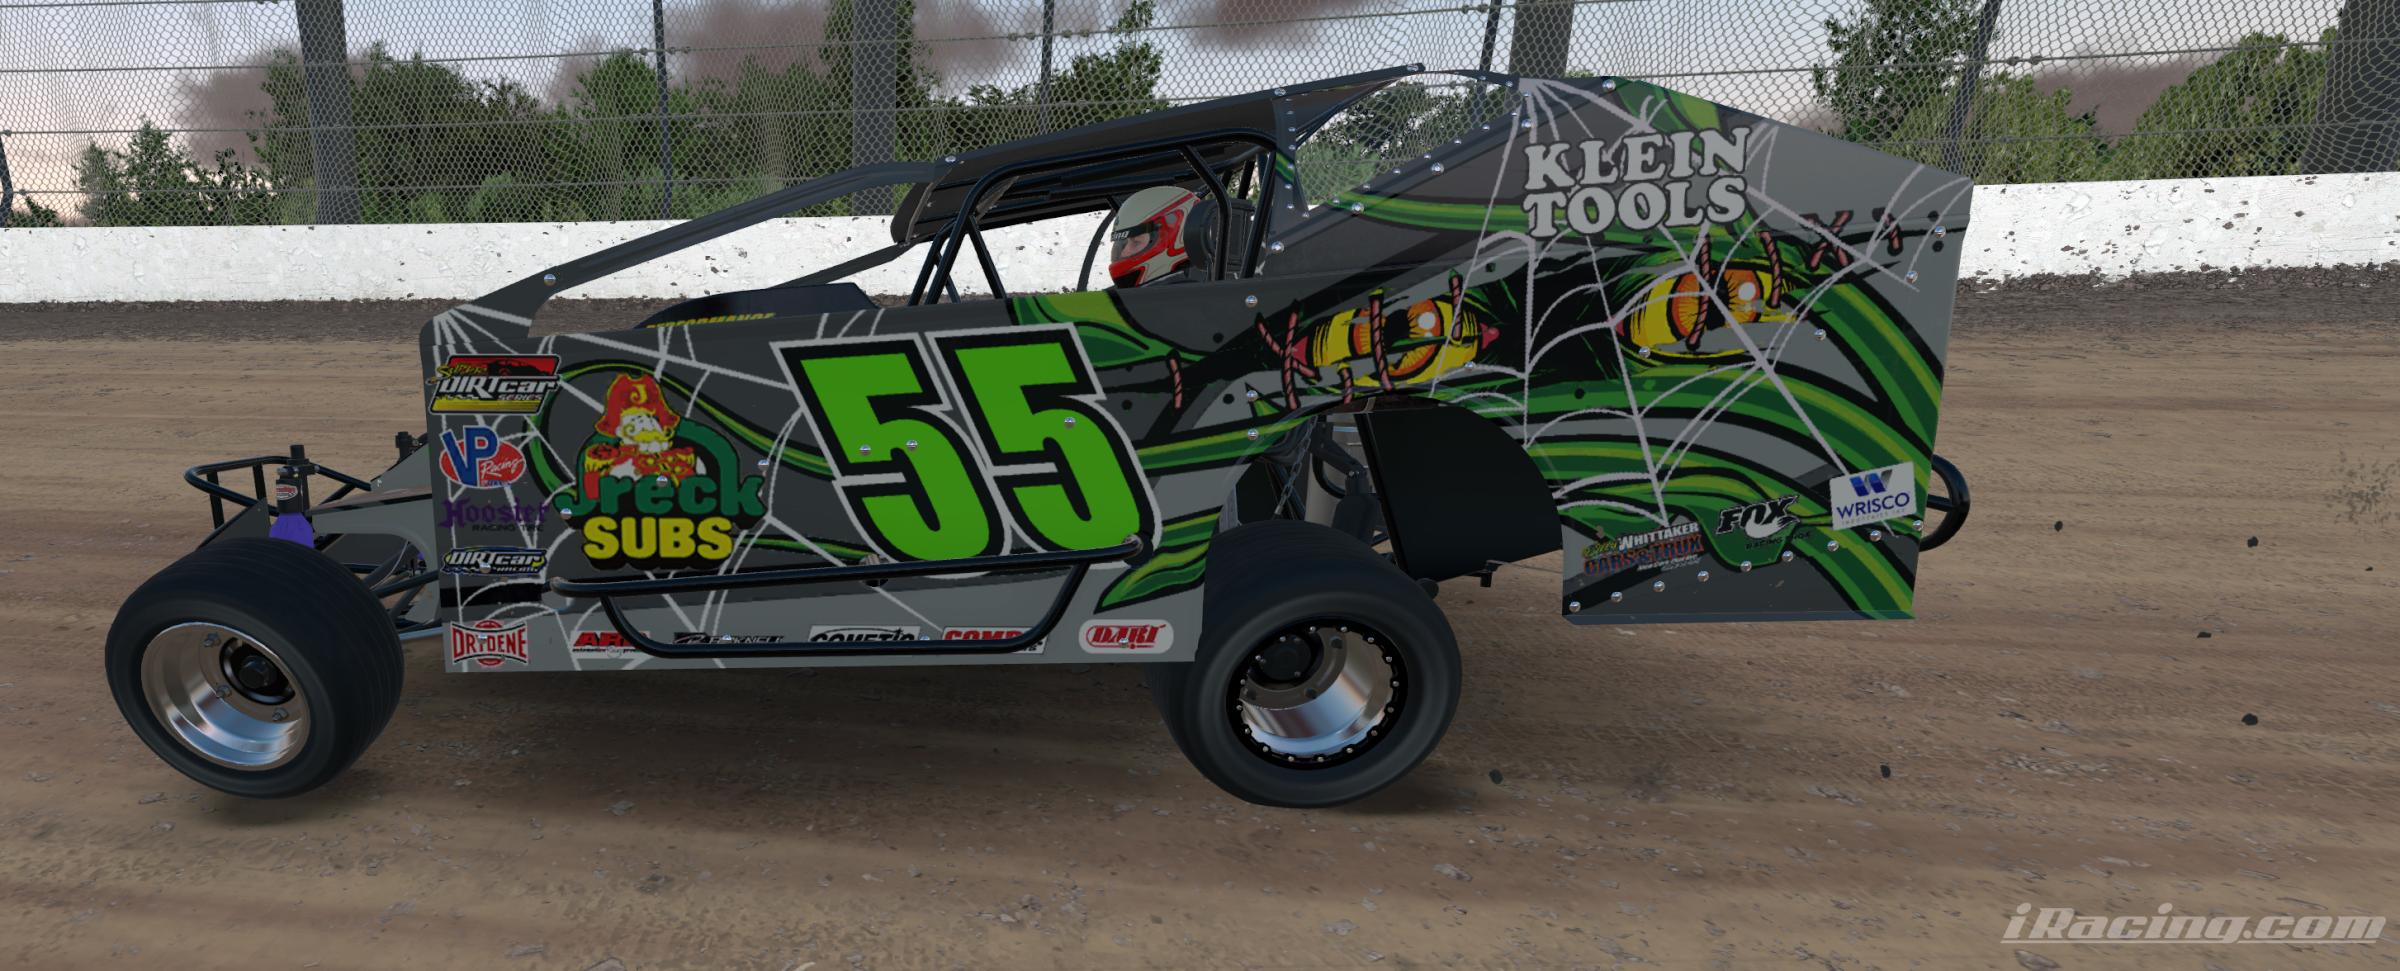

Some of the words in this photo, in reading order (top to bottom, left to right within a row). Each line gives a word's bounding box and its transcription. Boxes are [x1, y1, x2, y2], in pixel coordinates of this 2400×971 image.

[1524, 127, 1751, 190] KLEIN
[1522, 175, 1748, 237] TOOLS
[440, 426, 498, 487] VP
[480, 457, 525, 478] Racing
[788, 332, 1150, 566] 55
[1715, 495, 1800, 536] FOX
[1836, 492, 1910, 520] WRISCO
[582, 516, 733, 561] SUBS
[1619, 521, 1699, 550] WHITTAKER
[449, 551, 542, 566] DIRTcar
